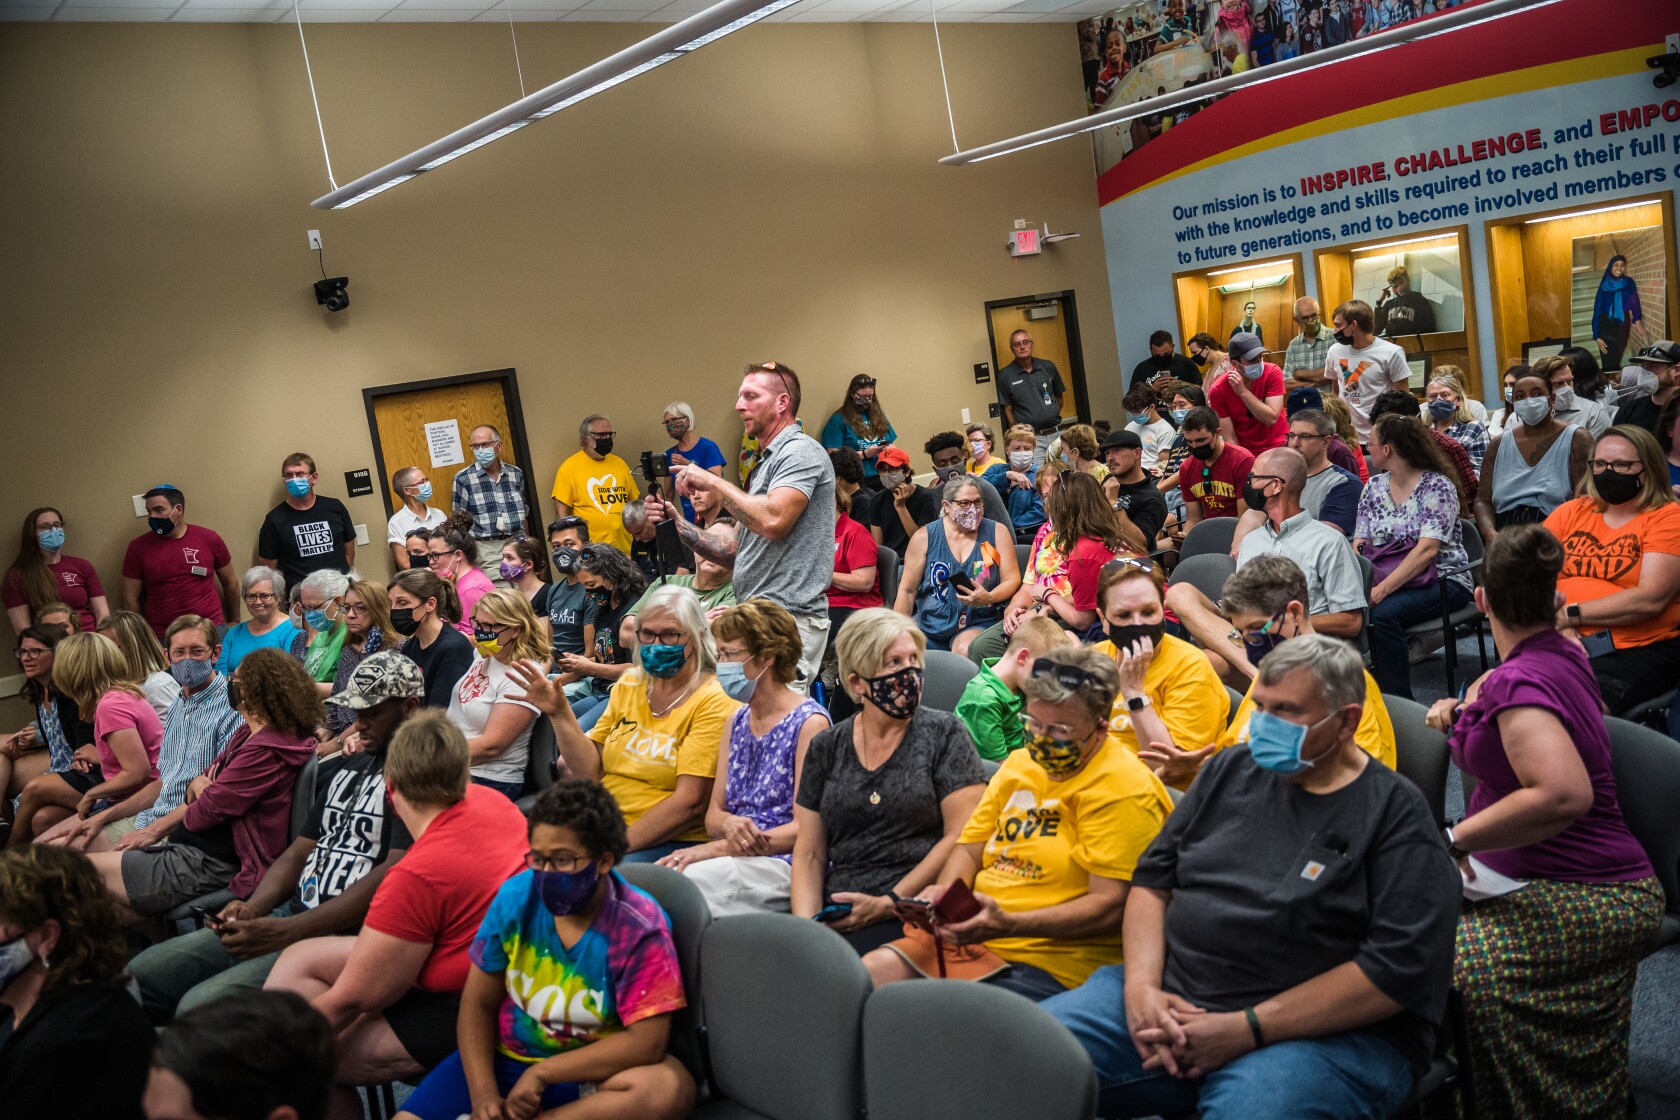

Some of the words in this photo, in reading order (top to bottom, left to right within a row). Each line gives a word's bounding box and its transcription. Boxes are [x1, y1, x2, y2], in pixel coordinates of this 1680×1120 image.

[1173, 205, 1199, 220] Our
[1202, 192, 1259, 215] mission
[1263, 188, 1276, 203] is
[1280, 184, 1296, 199] to
[1300, 161, 1392, 196] INSPIRE,
[1394, 128, 1548, 176] CHALLENGE,
[1554, 119, 1592, 144] and
[1175, 227, 1204, 242] with
[1208, 222, 1230, 236] the
[1234, 206, 1316, 232] knowledge
[1320, 196, 1350, 216] and
[1356, 188, 1400, 209] skills
[1404, 170, 1480, 200] required
[1486, 168, 1506, 184] to
[1512, 154, 1568, 179] reach
[1574, 146, 1622, 168] their
[1629, 133, 1666, 157] full
[1178, 250, 1192, 264] to
[1195, 243, 1236, 262] future
[1241, 226, 1336, 257] generations,
[1340, 216, 1372, 236] and
[1376, 215, 1394, 230] to
[1398, 202, 1469, 226] become
[1475, 182, 1558, 213] involved
[1564, 167, 1667, 198] members
[1017, 230, 1037, 252] EXIT
[600, 494, 628, 504] LOVE
[297, 530, 330, 547] LIVES
[298, 523, 325, 532] BLACK
[302, 544, 332, 556] MATTER
[1564, 536, 1636, 556] CHOOSE
[1562, 556, 1633, 580] KIND
[625, 730, 677, 760] LOVE
[996, 818, 1060, 842] LOVE
